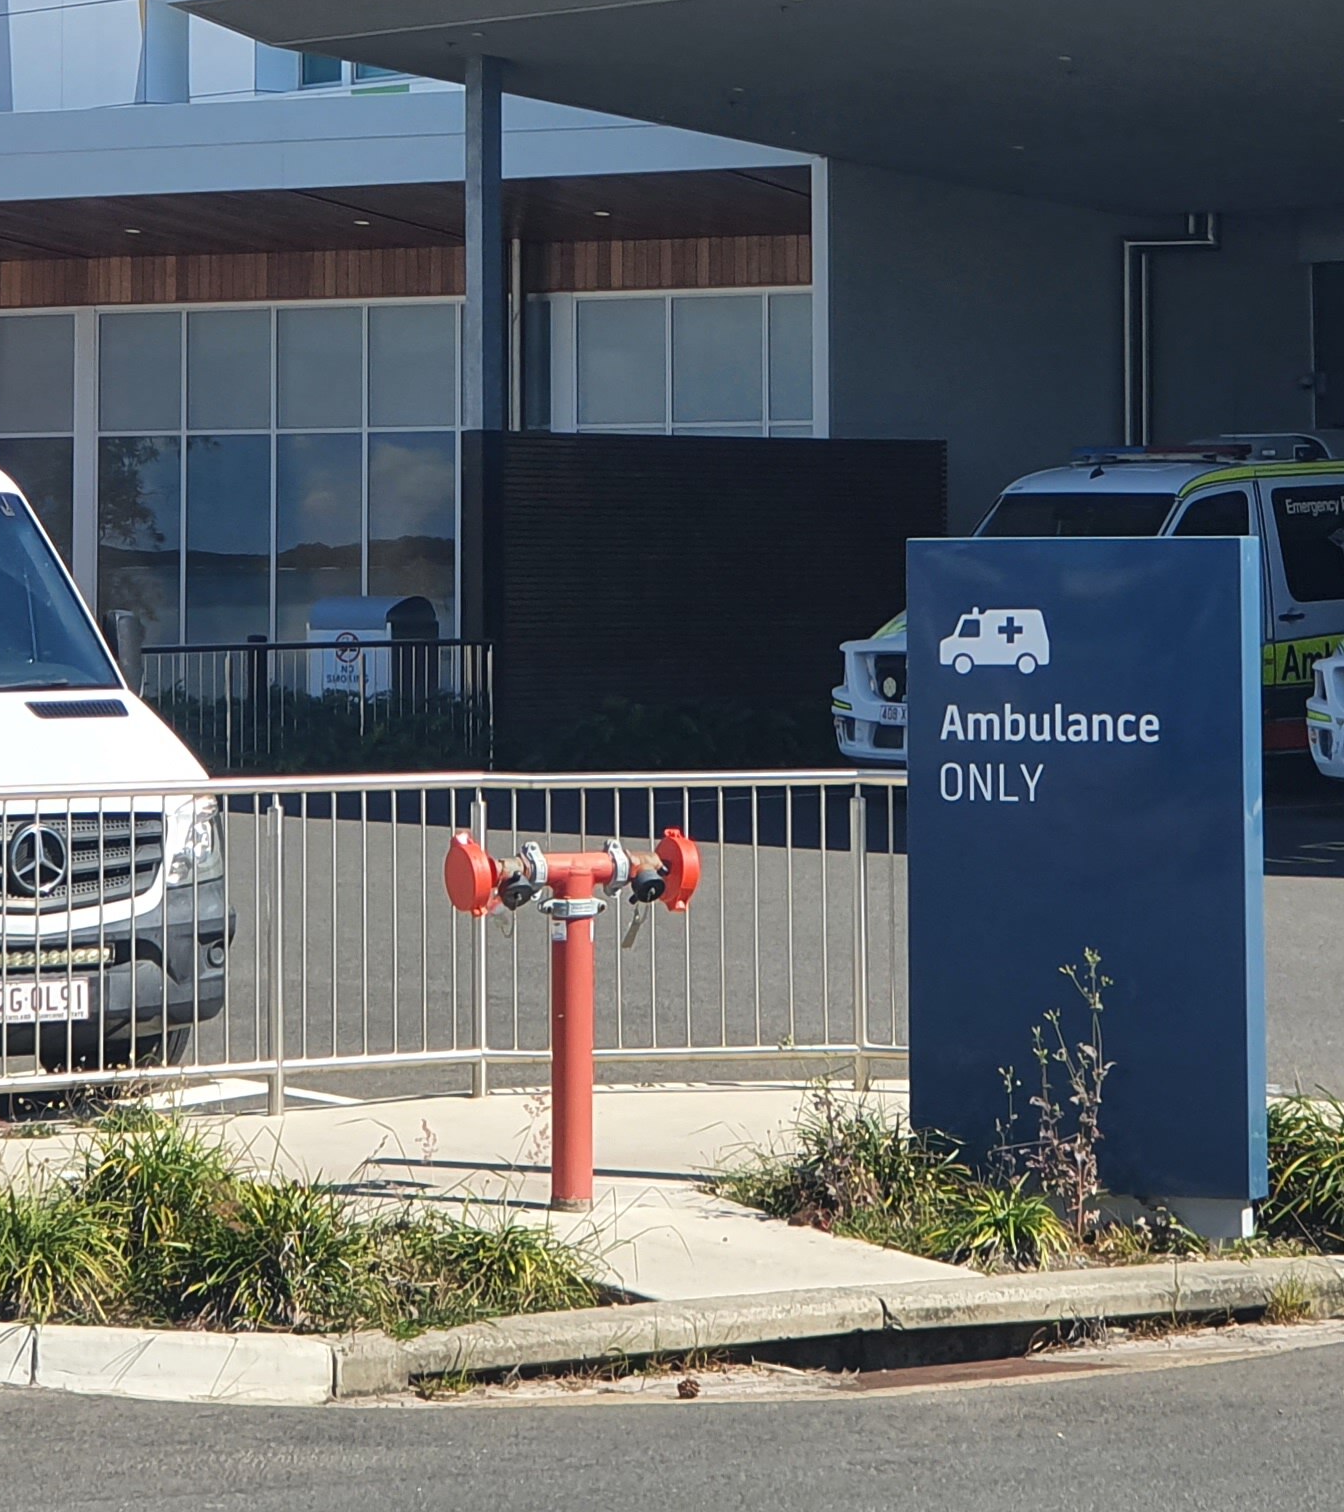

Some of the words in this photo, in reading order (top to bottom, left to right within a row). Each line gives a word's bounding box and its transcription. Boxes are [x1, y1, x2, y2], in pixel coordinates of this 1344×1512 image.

[1284, 498, 1340, 517] Emergency
[940, 703, 1161, 743] Ambulance
[940, 762, 1044, 803] ONLY
